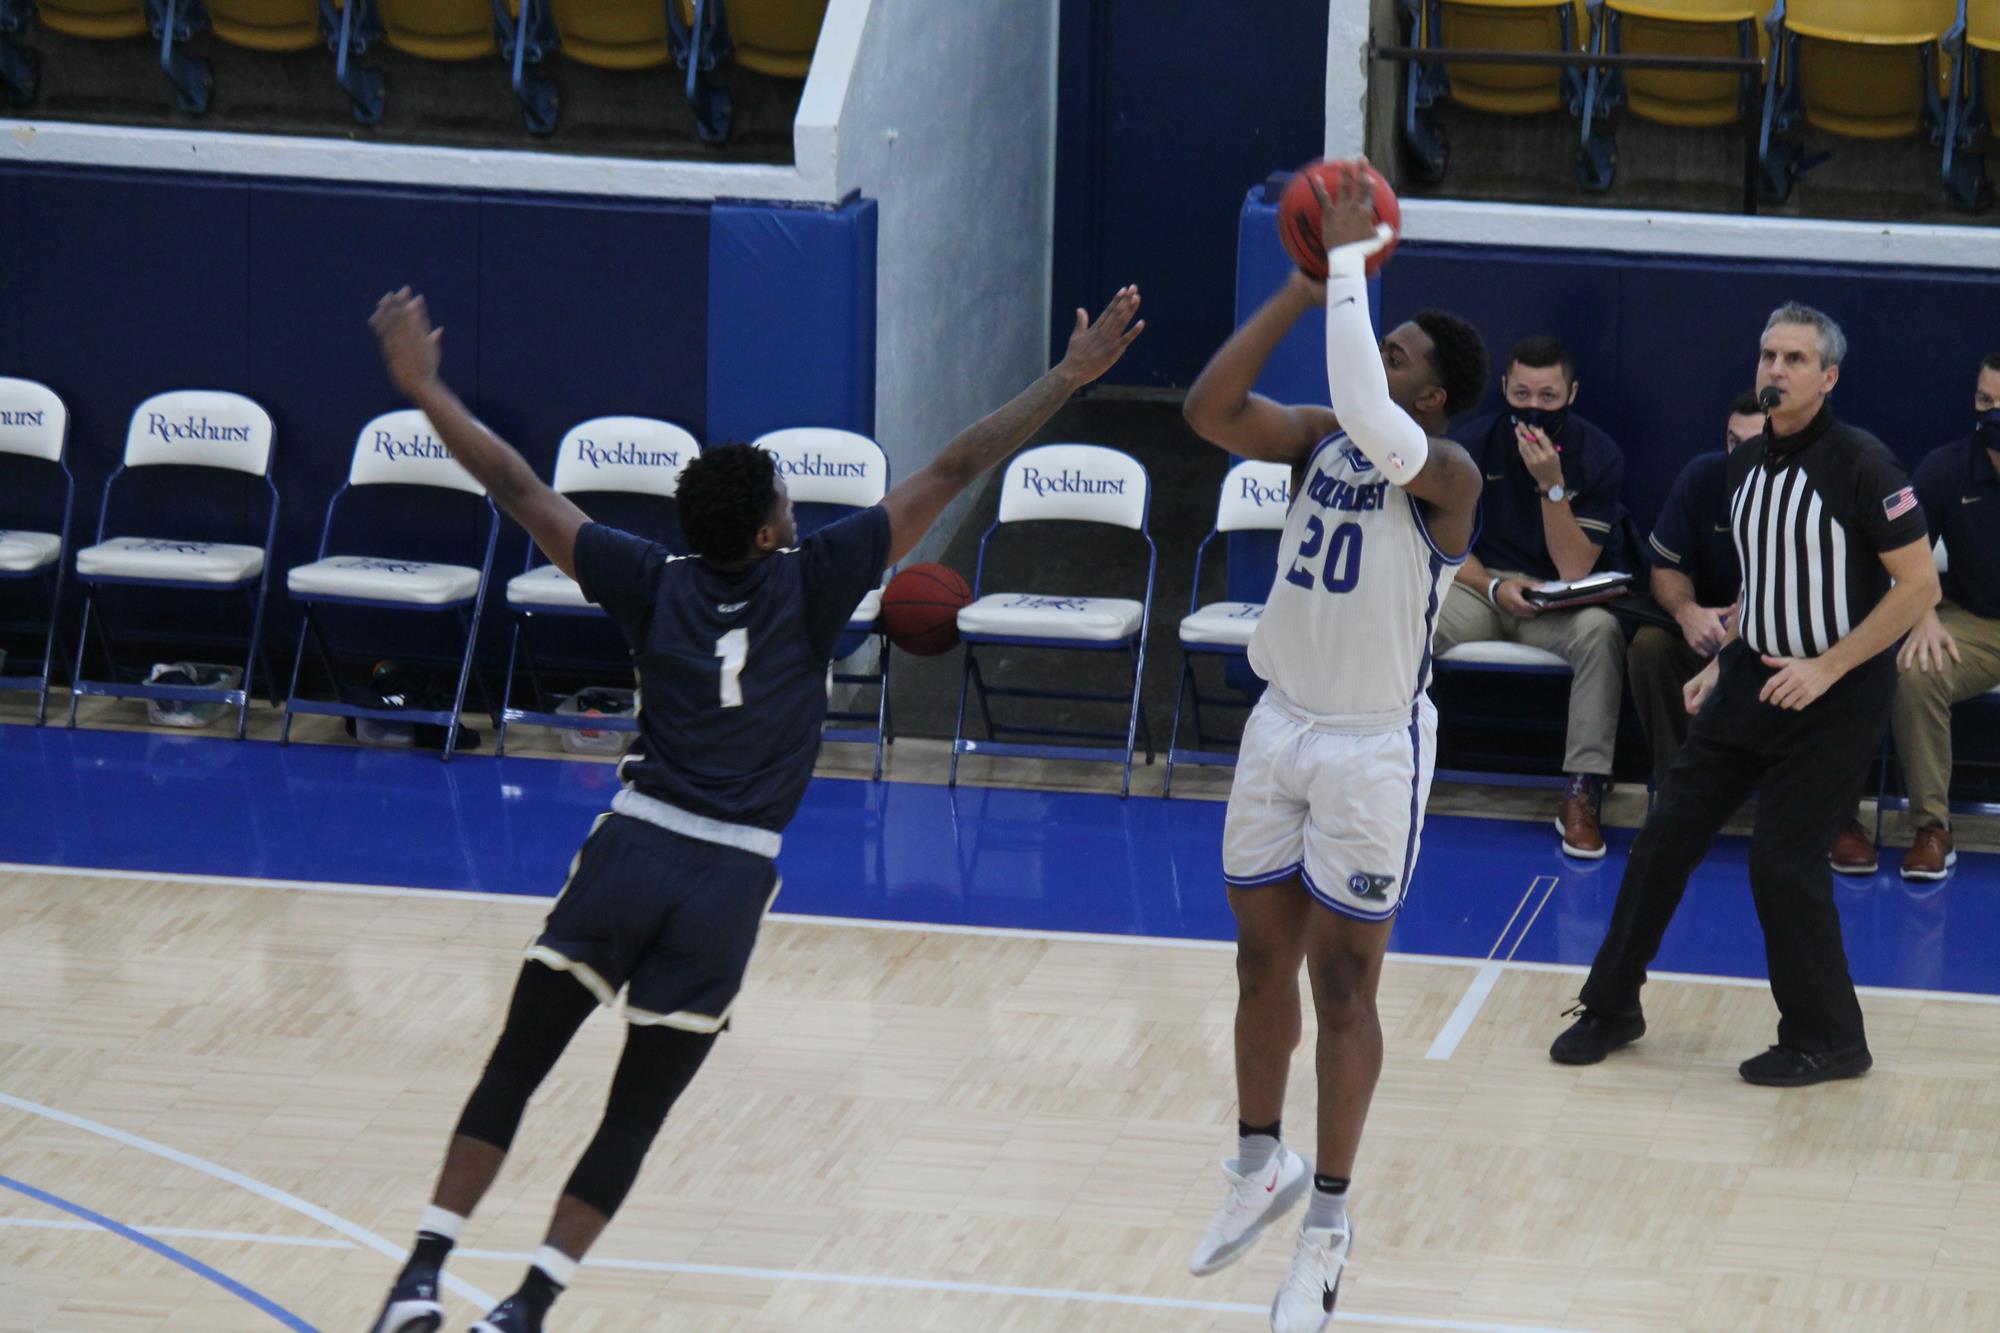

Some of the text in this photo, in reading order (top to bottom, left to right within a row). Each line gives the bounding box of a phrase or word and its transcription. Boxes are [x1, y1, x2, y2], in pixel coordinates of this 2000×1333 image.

[148, 412, 251, 443] Rockhurst
[577, 439, 680, 469] Rockhurst
[768, 449, 868, 480] Rockhurst
[1022, 466, 1127, 497] Rockhurst
[1285, 514, 1364, 594] 20
[714, 627, 749, 709] 1
